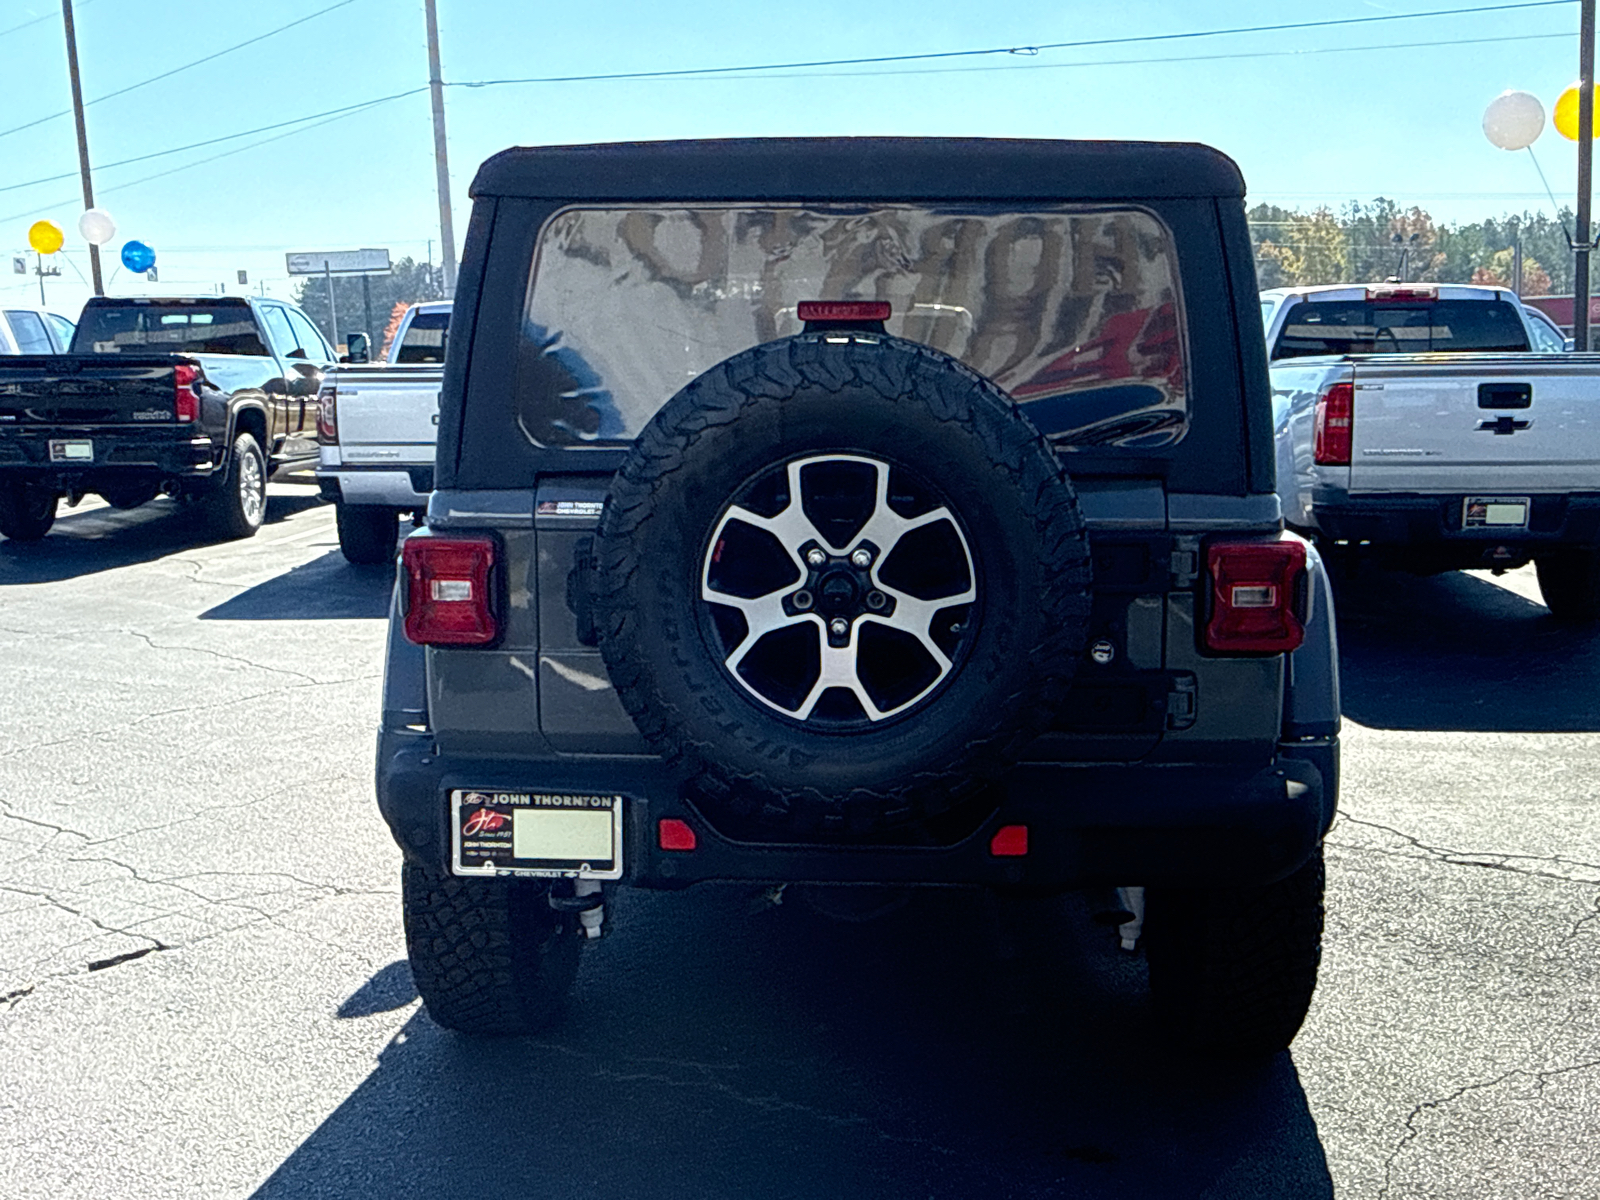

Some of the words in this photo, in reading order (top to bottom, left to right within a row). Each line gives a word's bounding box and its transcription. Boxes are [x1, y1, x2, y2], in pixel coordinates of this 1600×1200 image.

[491, 793, 530, 805] JOHN
[533, 794, 612, 807] THORNTON
[514, 870, 562, 878] CHEVROLET
